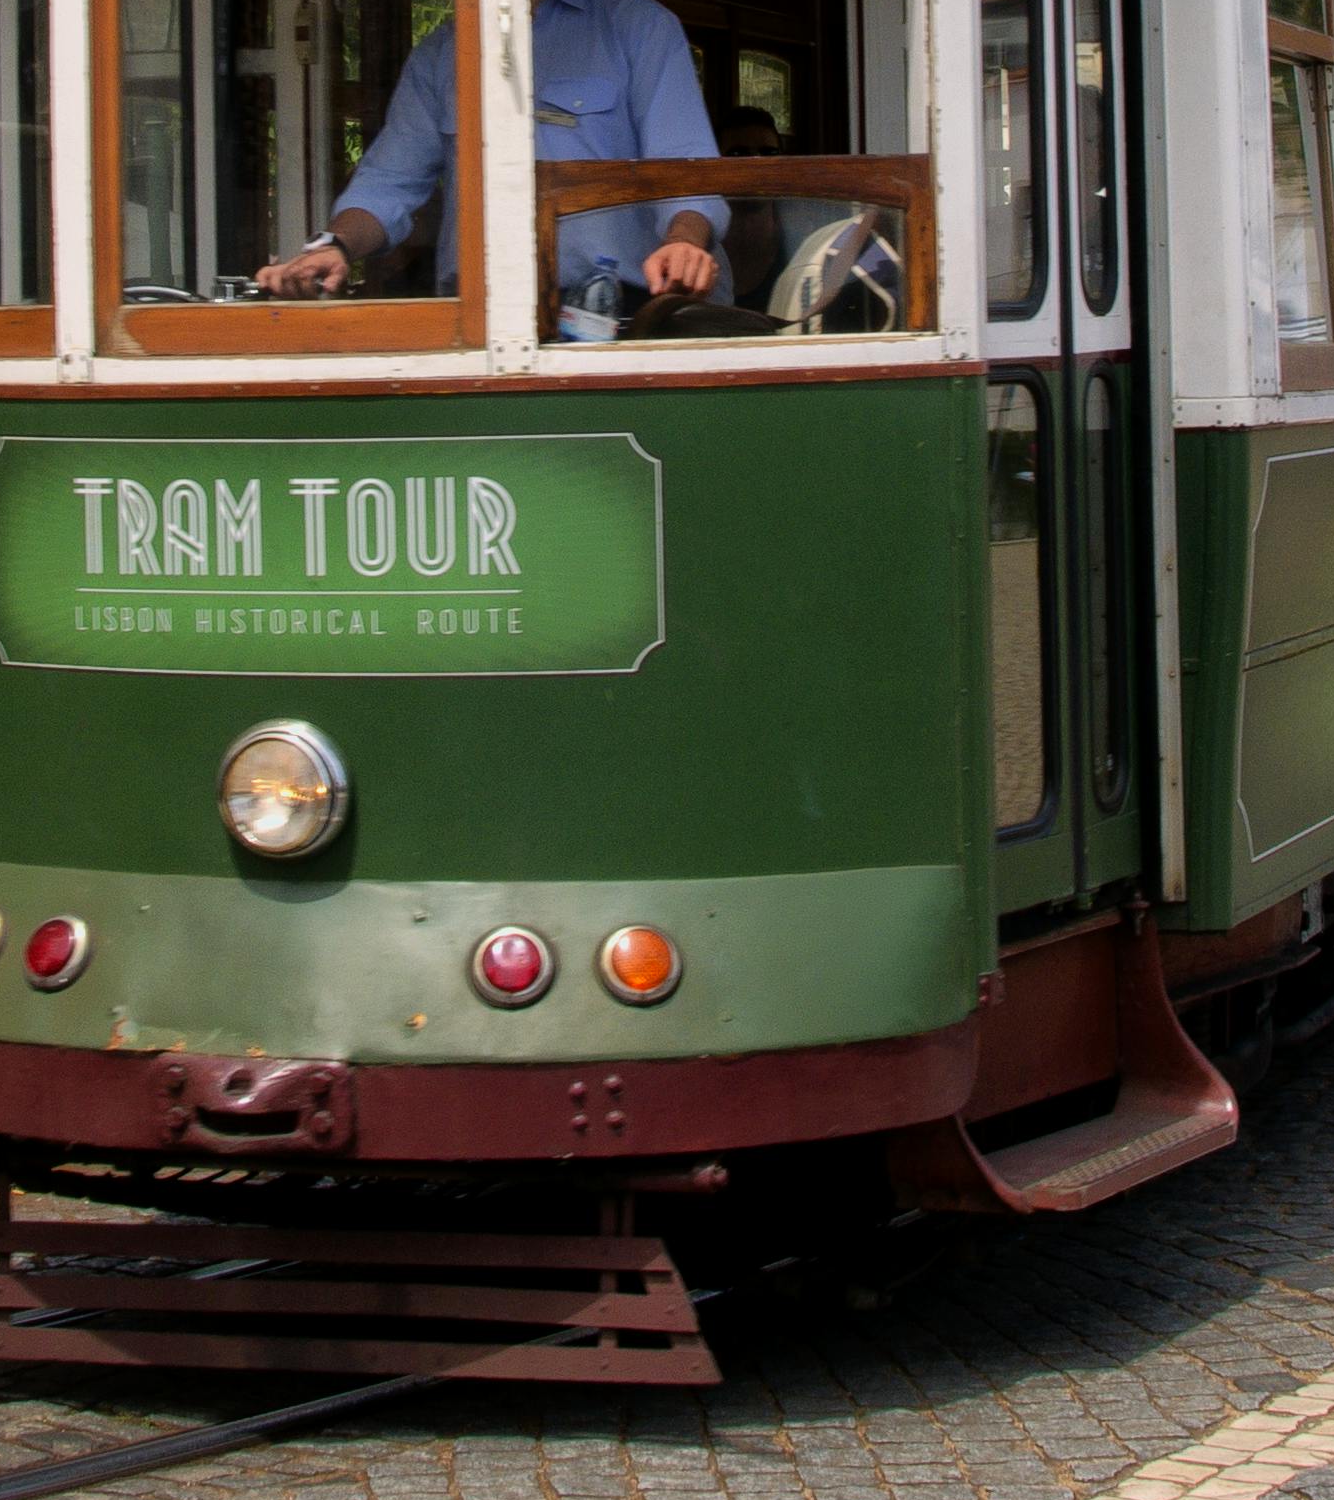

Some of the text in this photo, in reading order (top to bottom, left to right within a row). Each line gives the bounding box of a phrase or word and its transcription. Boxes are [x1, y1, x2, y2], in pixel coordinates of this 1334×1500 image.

[72, 476, 523, 577] TRAM TOUR
[74, 605, 524, 636] LISBON HISTORICAL ROUTE
